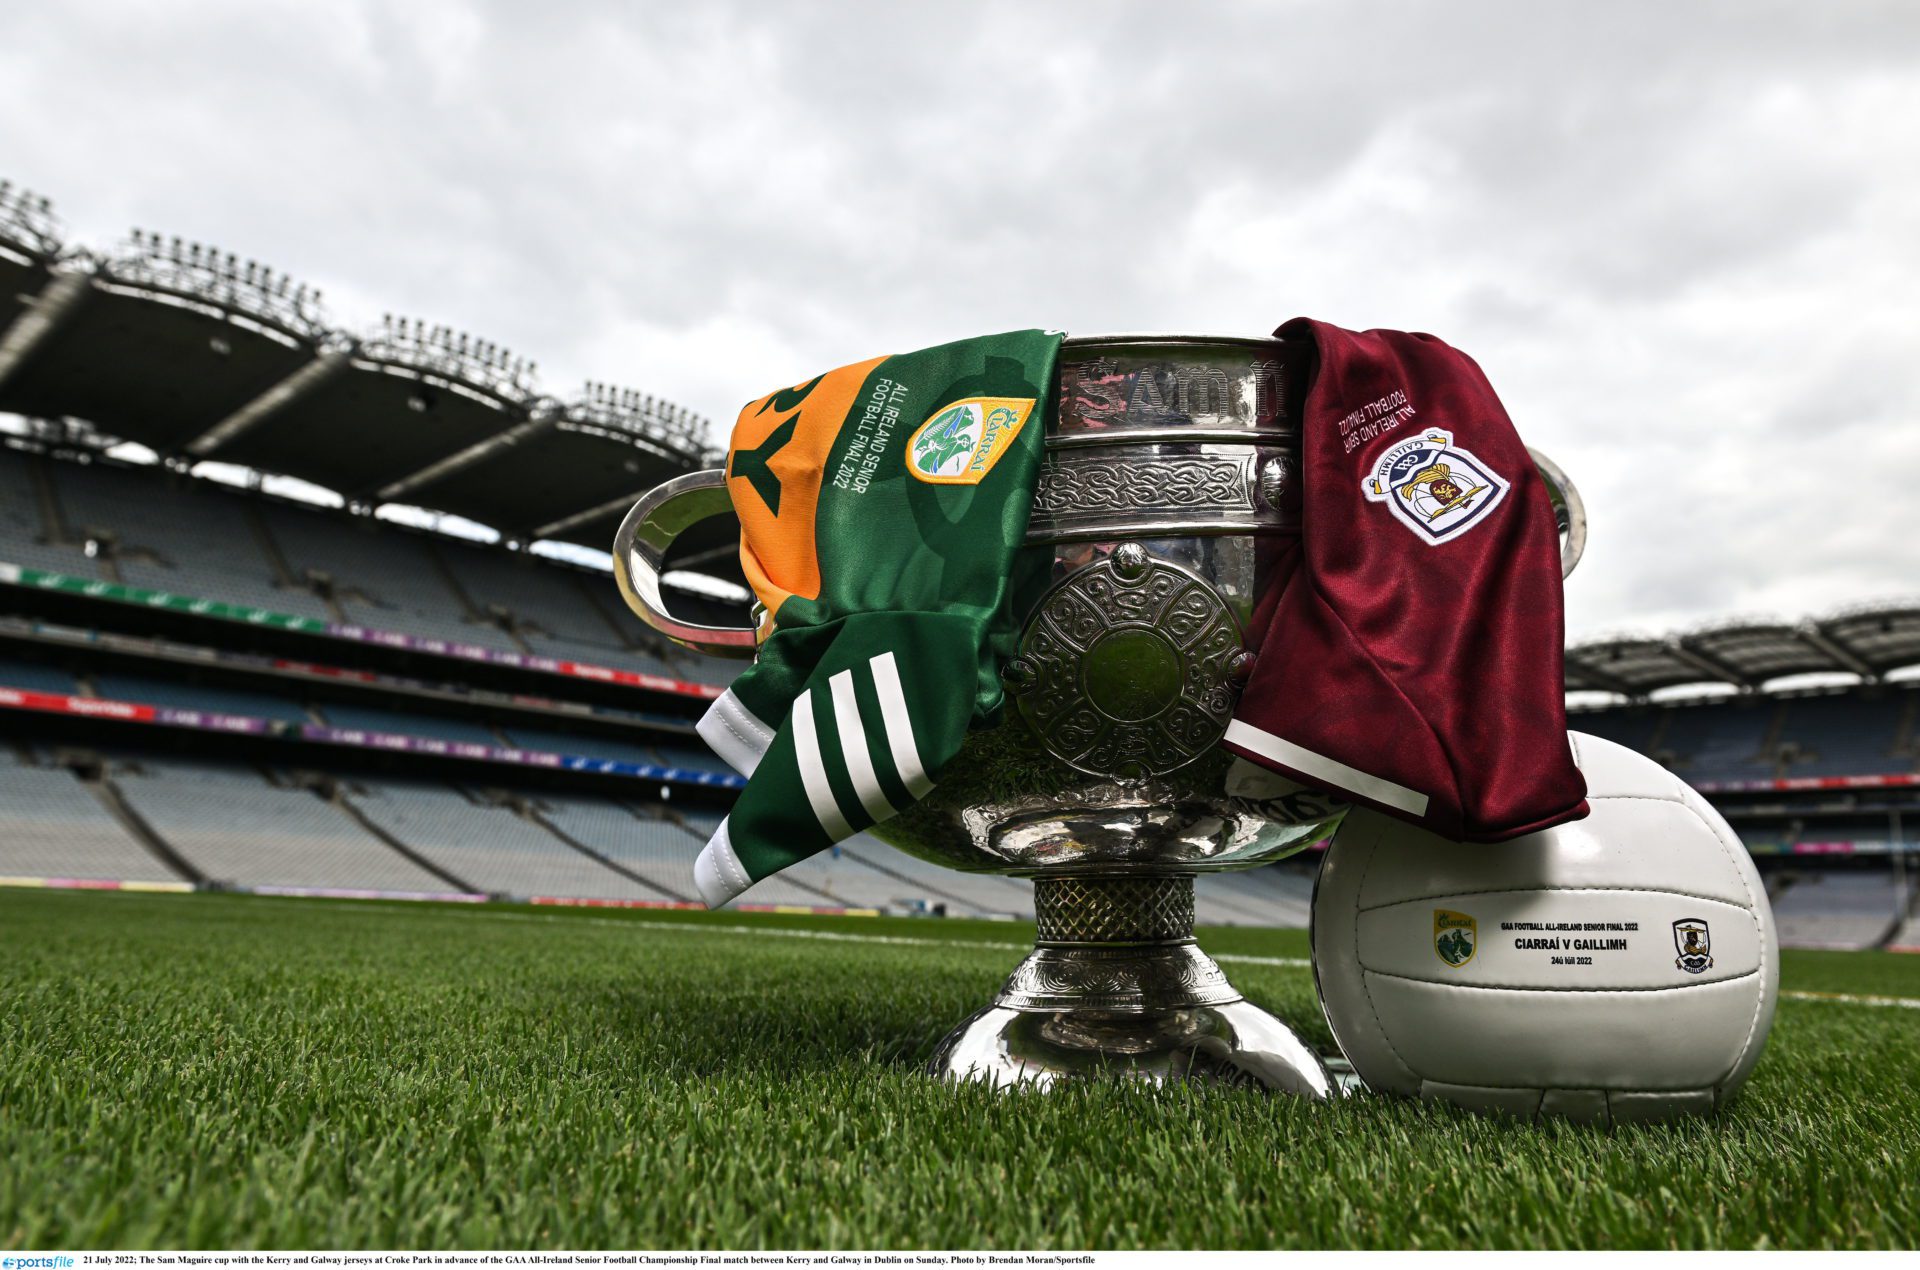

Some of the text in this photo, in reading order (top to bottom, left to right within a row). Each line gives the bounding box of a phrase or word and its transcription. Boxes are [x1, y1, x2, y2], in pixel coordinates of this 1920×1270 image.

[1364, 388, 1407, 418] FOOTBALL
[1395, 404, 1416, 421] ALL
[832, 377, 893, 489] FOOTBALL FINAL 2022
[850, 382, 909, 494] ALL IRELAND SENIOR
[1360, 413, 1400, 442] IRELAND
[1380, 441, 1424, 476] GAILLIMH
[1501, 922, 1638, 931] GAA FOOTBALL ALL-IRELAND SENIOR FINAL 2022
[1515, 936, 1627, 951] CIARRAÍ V GAILLIMH
[1576, 956, 1592, 965] 2022
